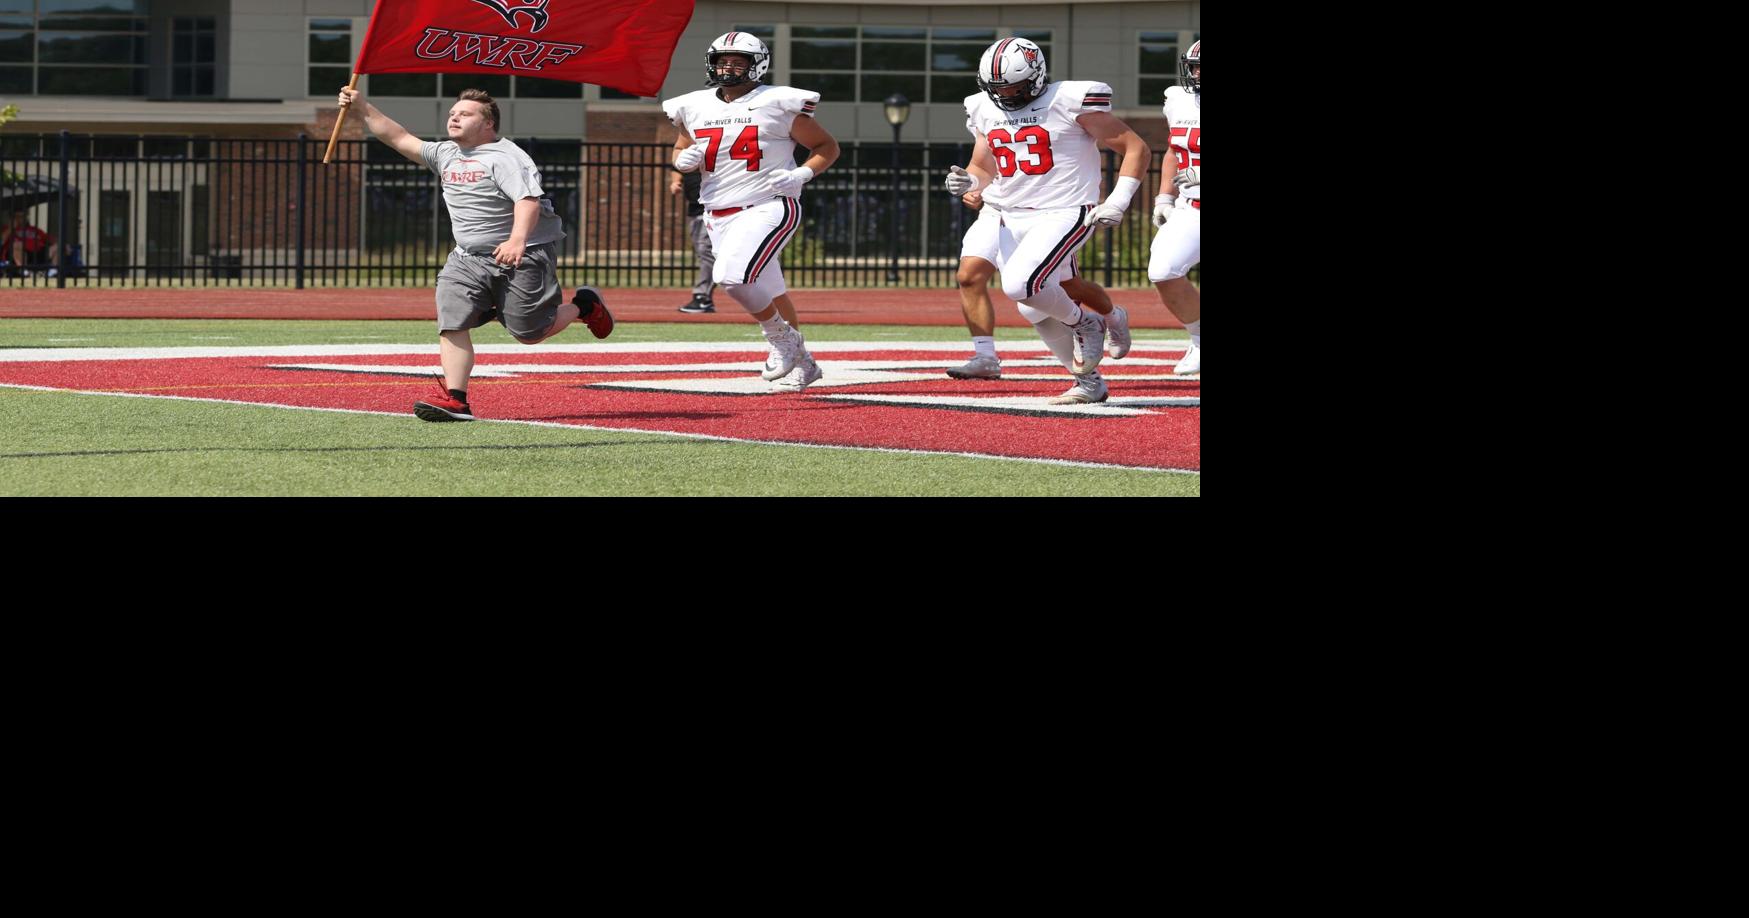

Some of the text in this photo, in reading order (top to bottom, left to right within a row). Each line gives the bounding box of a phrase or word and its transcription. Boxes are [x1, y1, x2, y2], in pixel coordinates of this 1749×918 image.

[415, 27, 584, 70] UWRF
[1020, 116, 1038, 124] FALLS
[693, 125, 763, 172] 74
[987, 124, 1054, 177] 63
